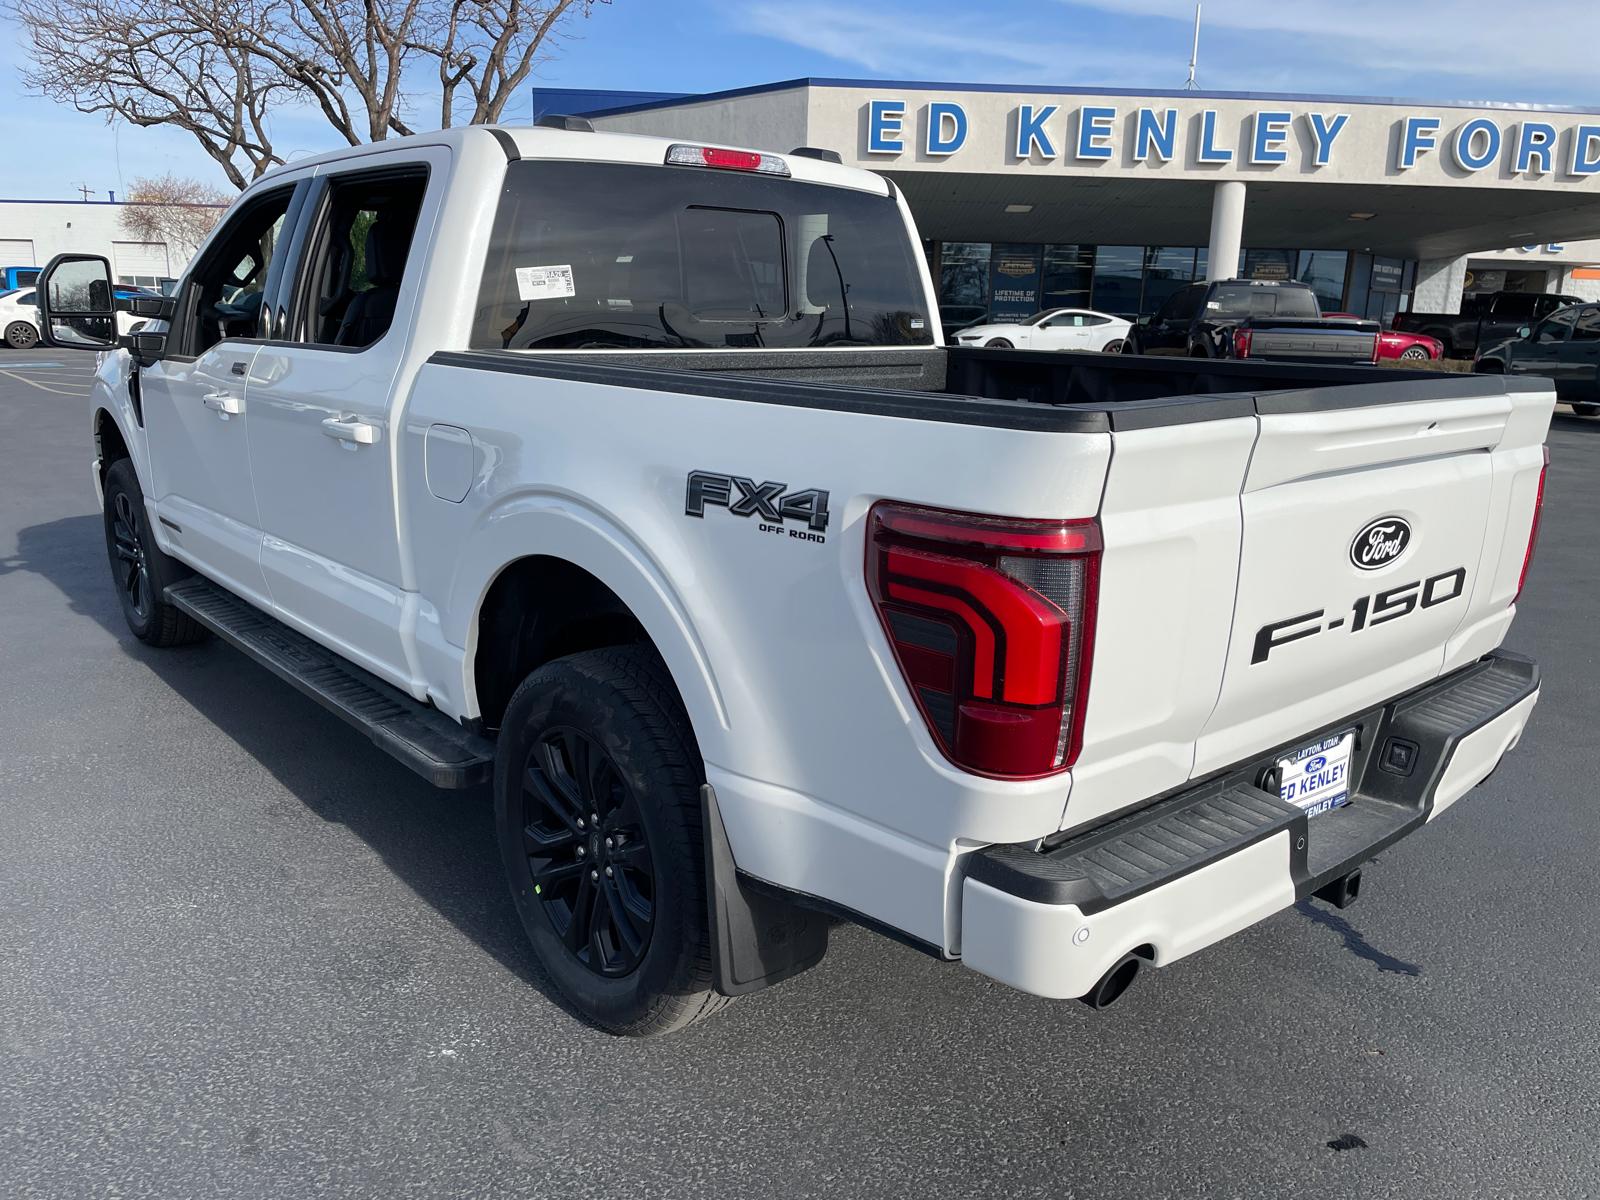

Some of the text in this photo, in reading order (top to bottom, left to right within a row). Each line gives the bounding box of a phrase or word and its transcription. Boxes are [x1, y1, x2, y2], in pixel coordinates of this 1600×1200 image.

[868, 99, 1600, 176] ED KENLEY FORD
[685, 469, 830, 533] FX4
[759, 523, 826, 544] OFF ROAD
[1361, 524, 1404, 563] Ford
[1250, 566, 1467, 665] F-150
[1323, 736, 1339, 750] UTAH
[1299, 762, 1346, 795] KENLEY
